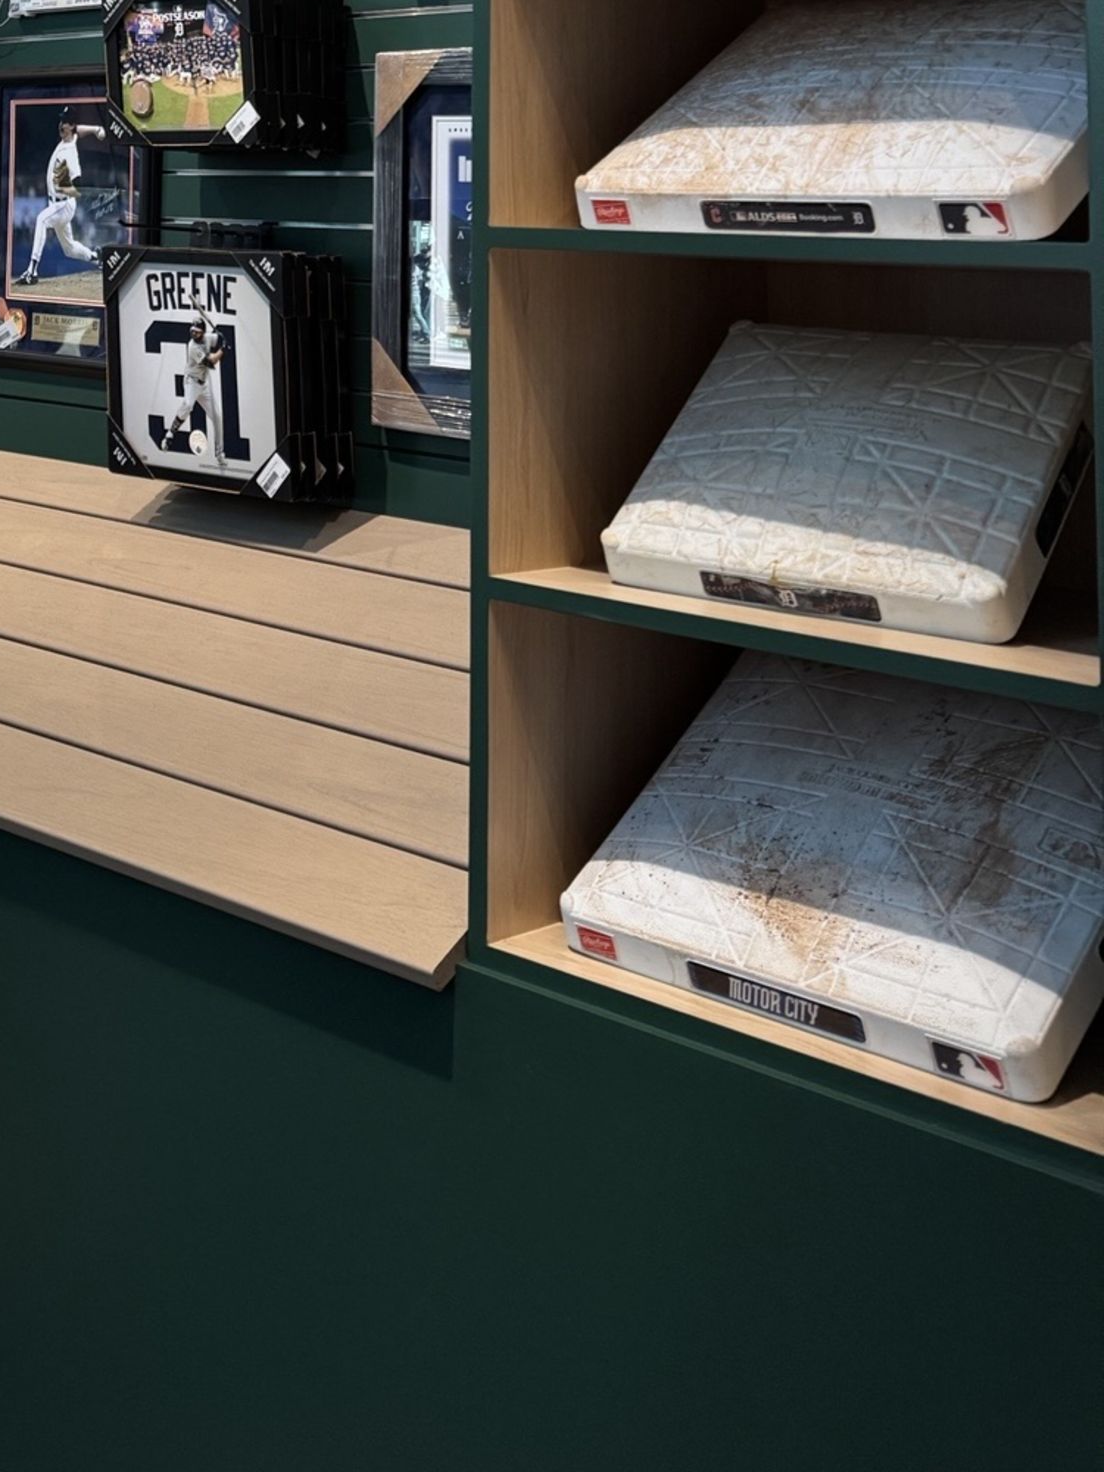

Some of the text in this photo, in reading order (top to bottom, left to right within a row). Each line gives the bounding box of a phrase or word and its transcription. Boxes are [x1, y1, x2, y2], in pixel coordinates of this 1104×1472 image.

[747, 212, 776, 222] ALDS
[799, 213, 844, 223] Booking.com
[145, 271, 237, 316] GREENE
[144, 320, 251, 461] 31
[728, 977, 820, 1025] MOTOR CITY
